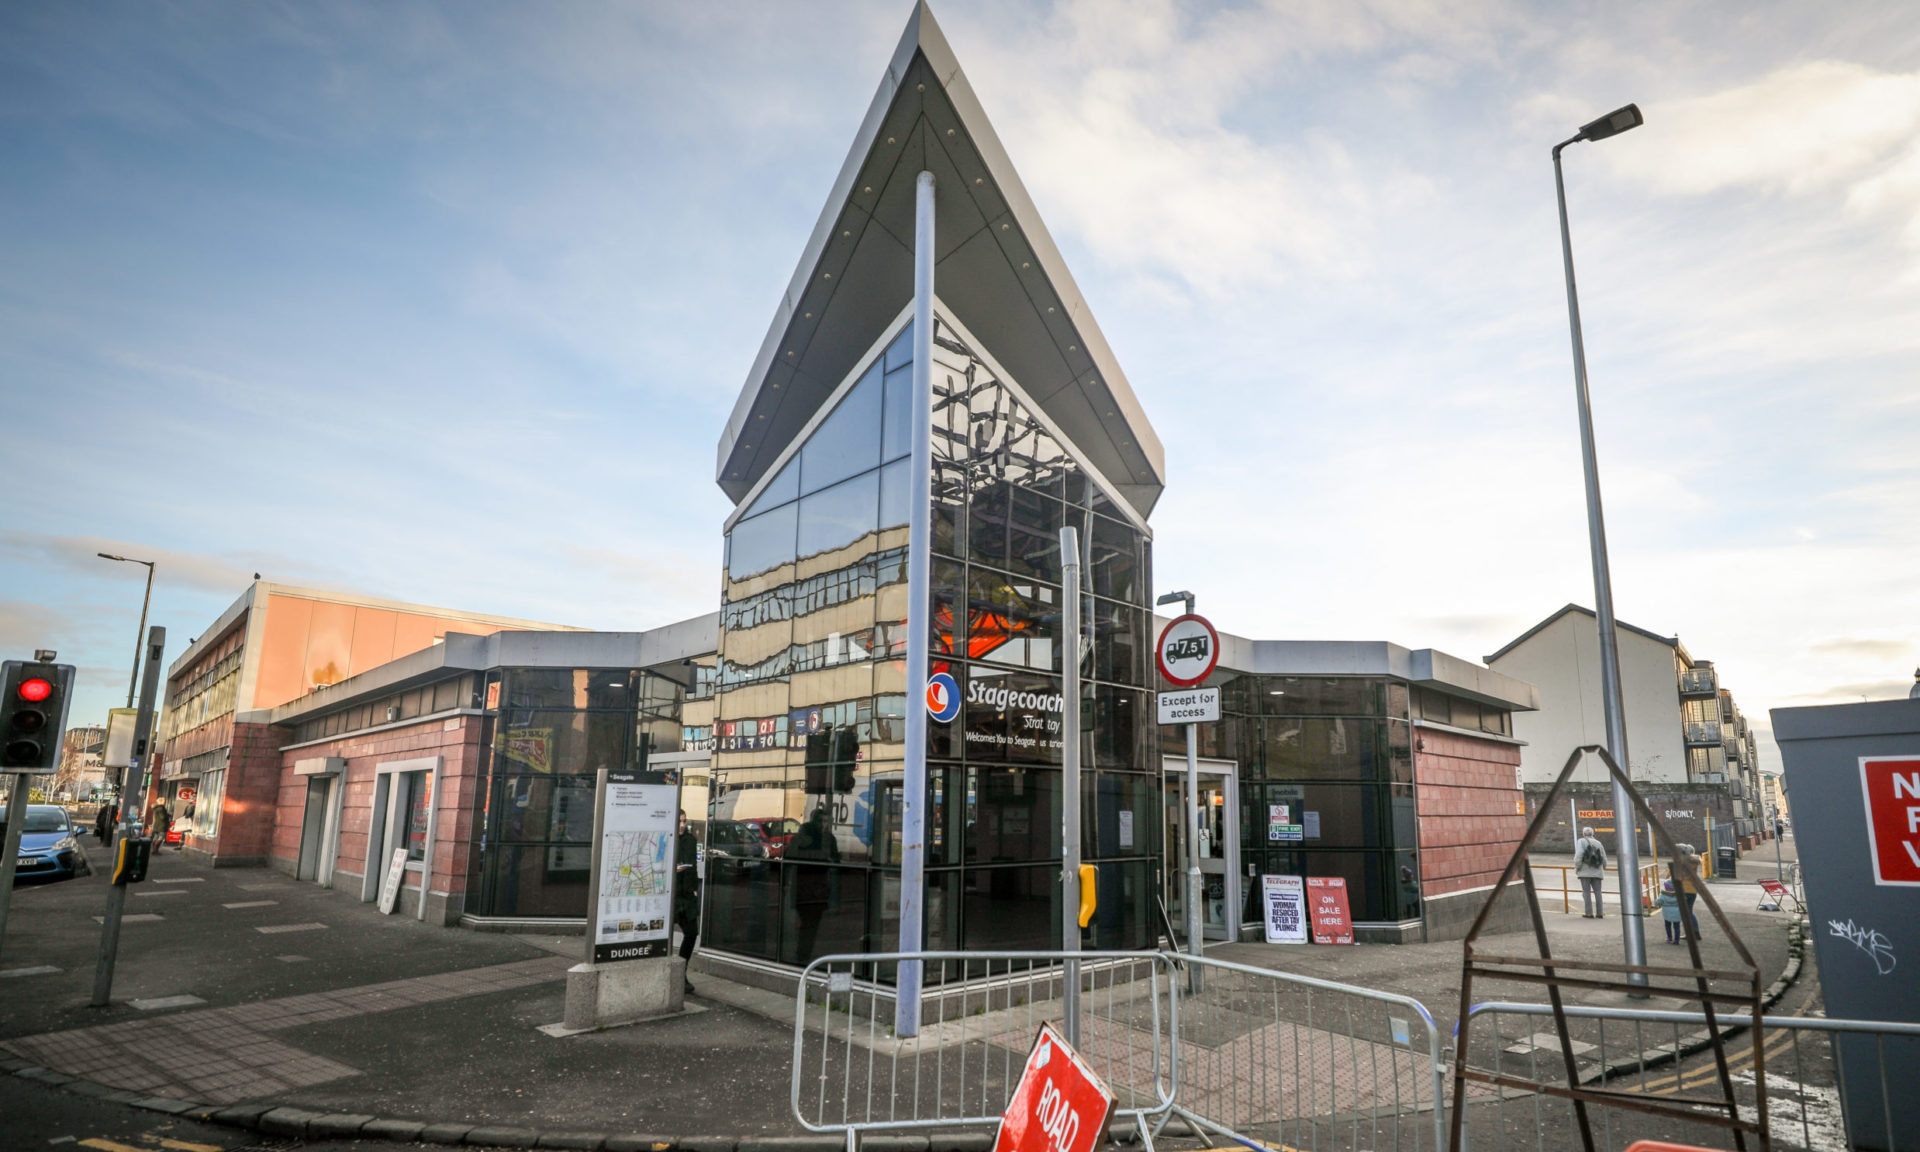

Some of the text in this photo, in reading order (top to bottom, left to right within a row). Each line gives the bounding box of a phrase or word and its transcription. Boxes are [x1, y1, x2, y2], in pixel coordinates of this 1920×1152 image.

[966, 680, 1064, 713] Stagecoach
[1161, 693, 1215, 707] Except for
[1170, 708, 1206, 719] access
[85, 758, 105, 768] M&
[1321, 896, 1335, 904] ON
[1319, 907, 1341, 915] SALE
[1320, 918, 1343, 926] HERE
[610, 946, 649, 959] DUNDEE
[1035, 1076, 1080, 1152] ROAD
